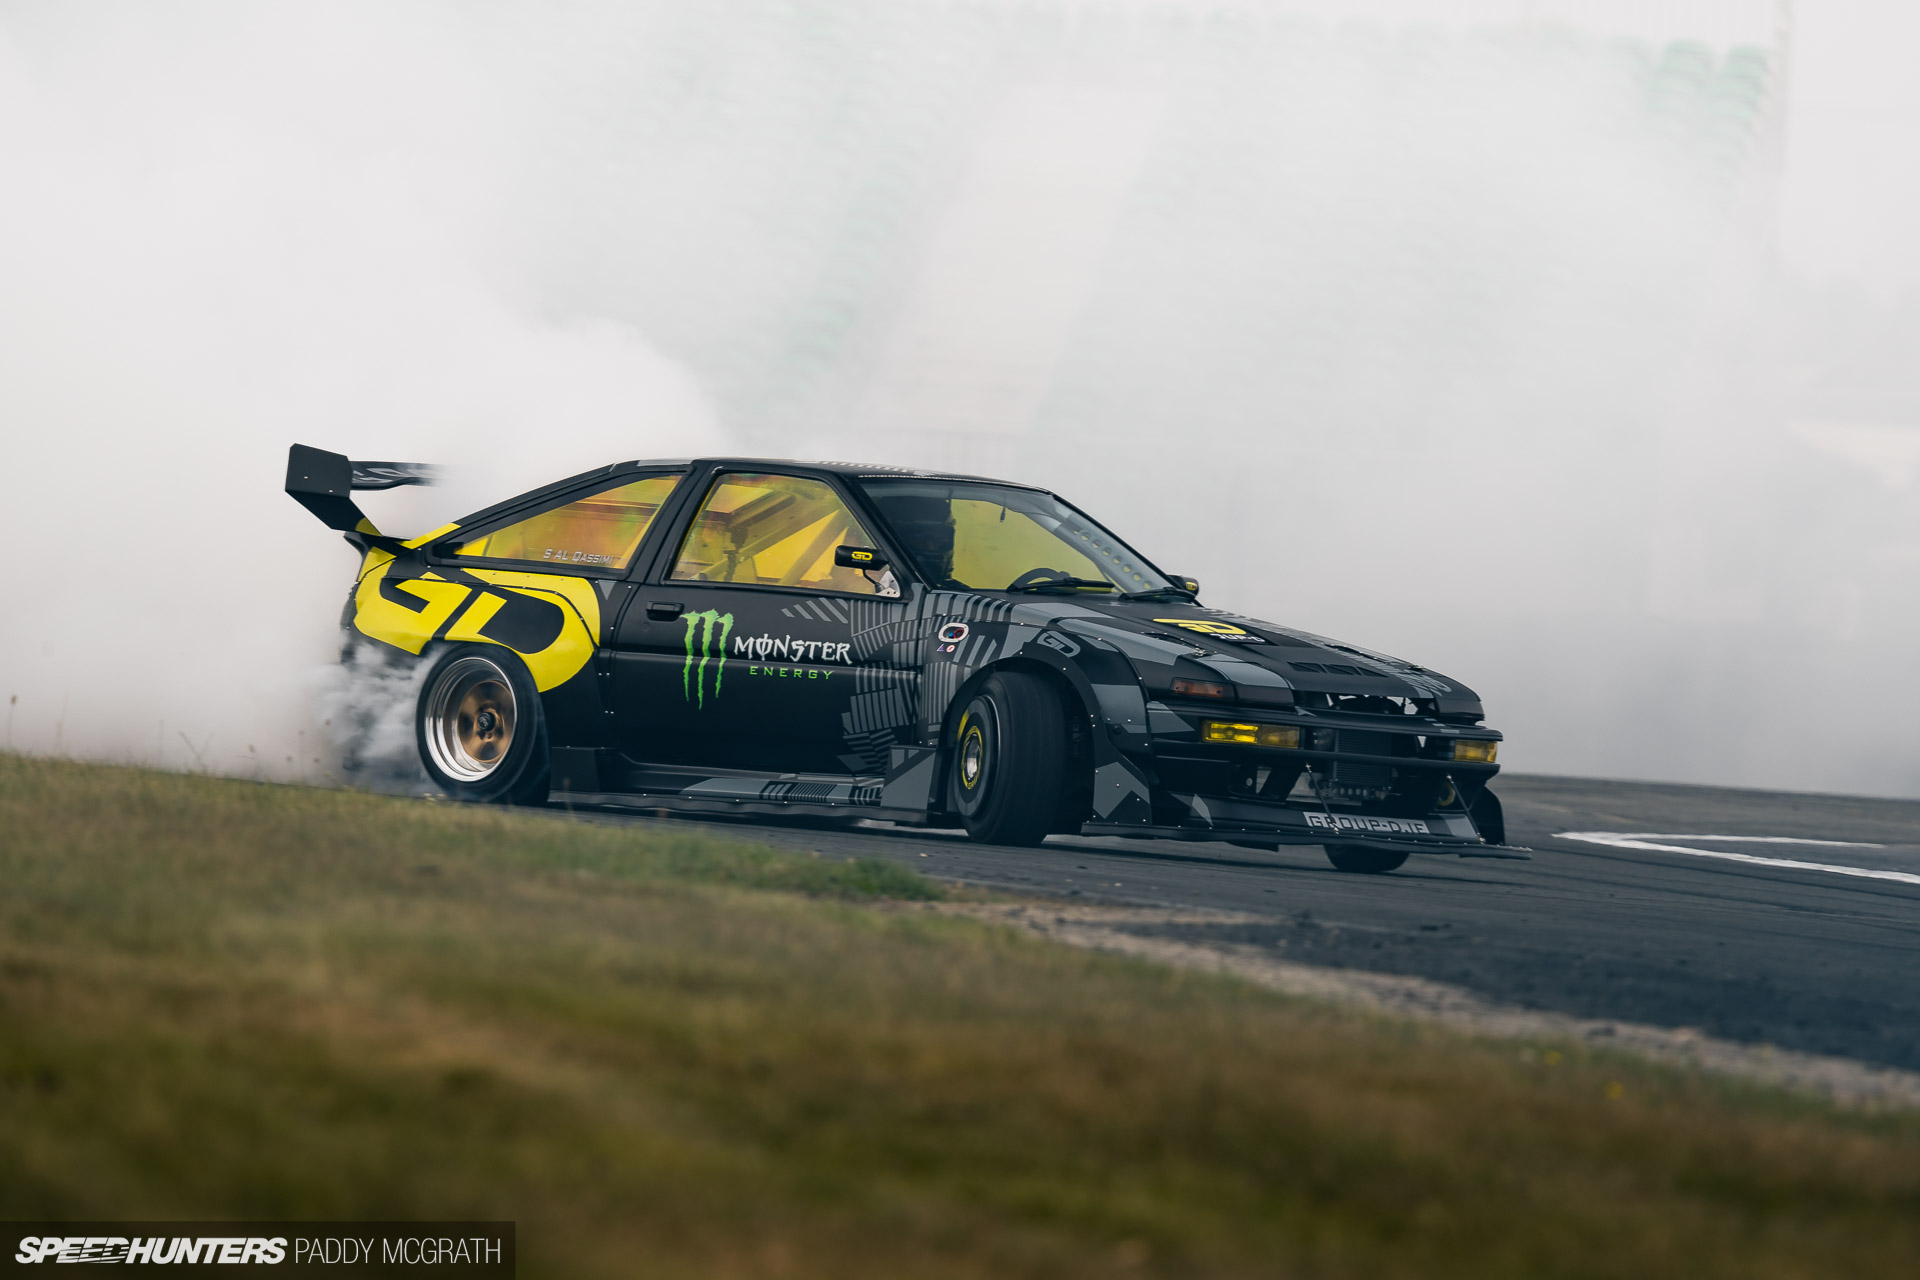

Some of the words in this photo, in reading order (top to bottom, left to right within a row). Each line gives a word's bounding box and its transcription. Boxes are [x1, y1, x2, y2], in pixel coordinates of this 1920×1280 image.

[543, 548, 553, 559] S
[555, 550, 569, 561] AL
[750, 665, 834, 680] ENERGY
